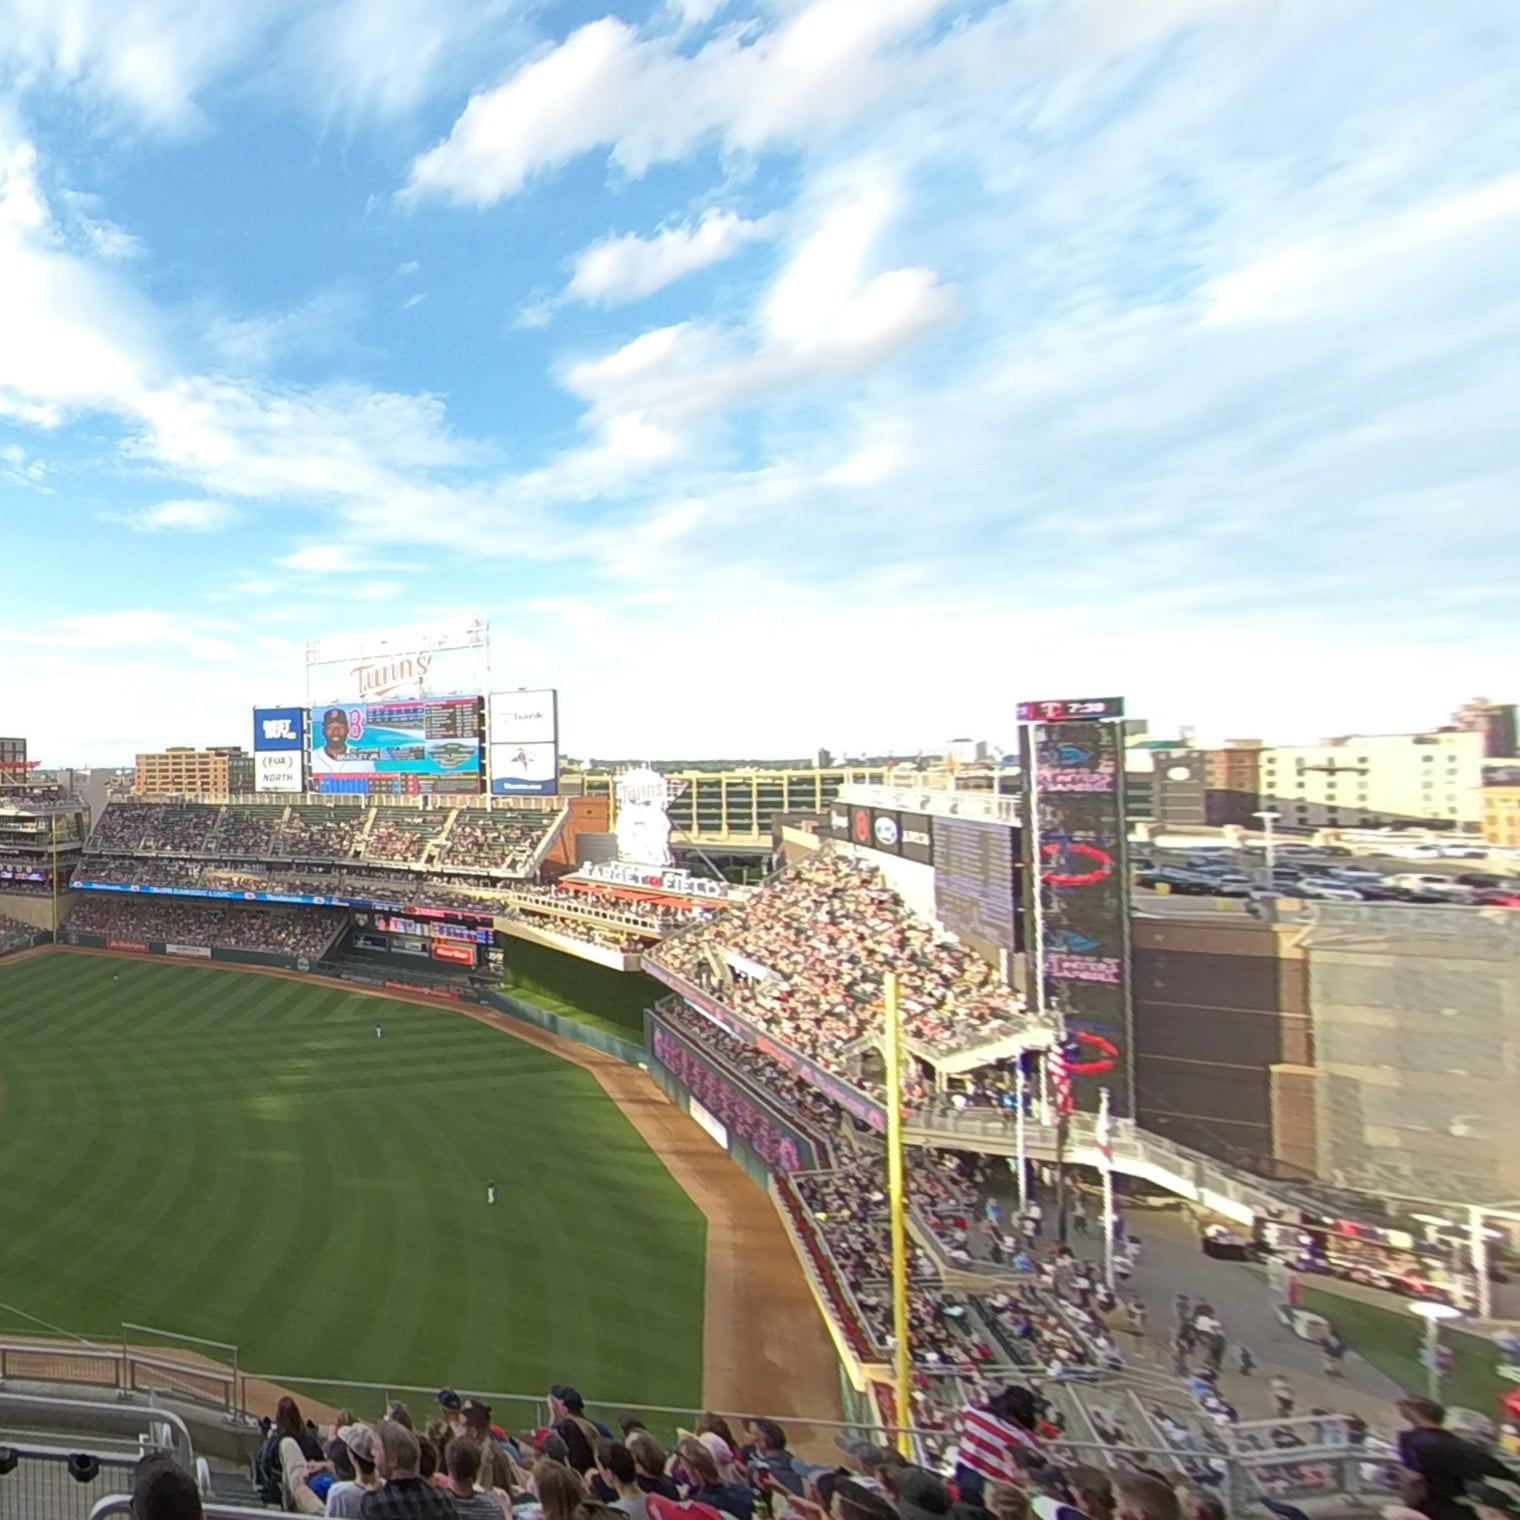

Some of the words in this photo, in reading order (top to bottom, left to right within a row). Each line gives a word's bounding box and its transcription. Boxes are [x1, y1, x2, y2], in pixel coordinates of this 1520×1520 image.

[350, 655, 429, 693] Twins
[583, 863, 648, 886] TARGET
[663, 876, 721, 897] FIELD
